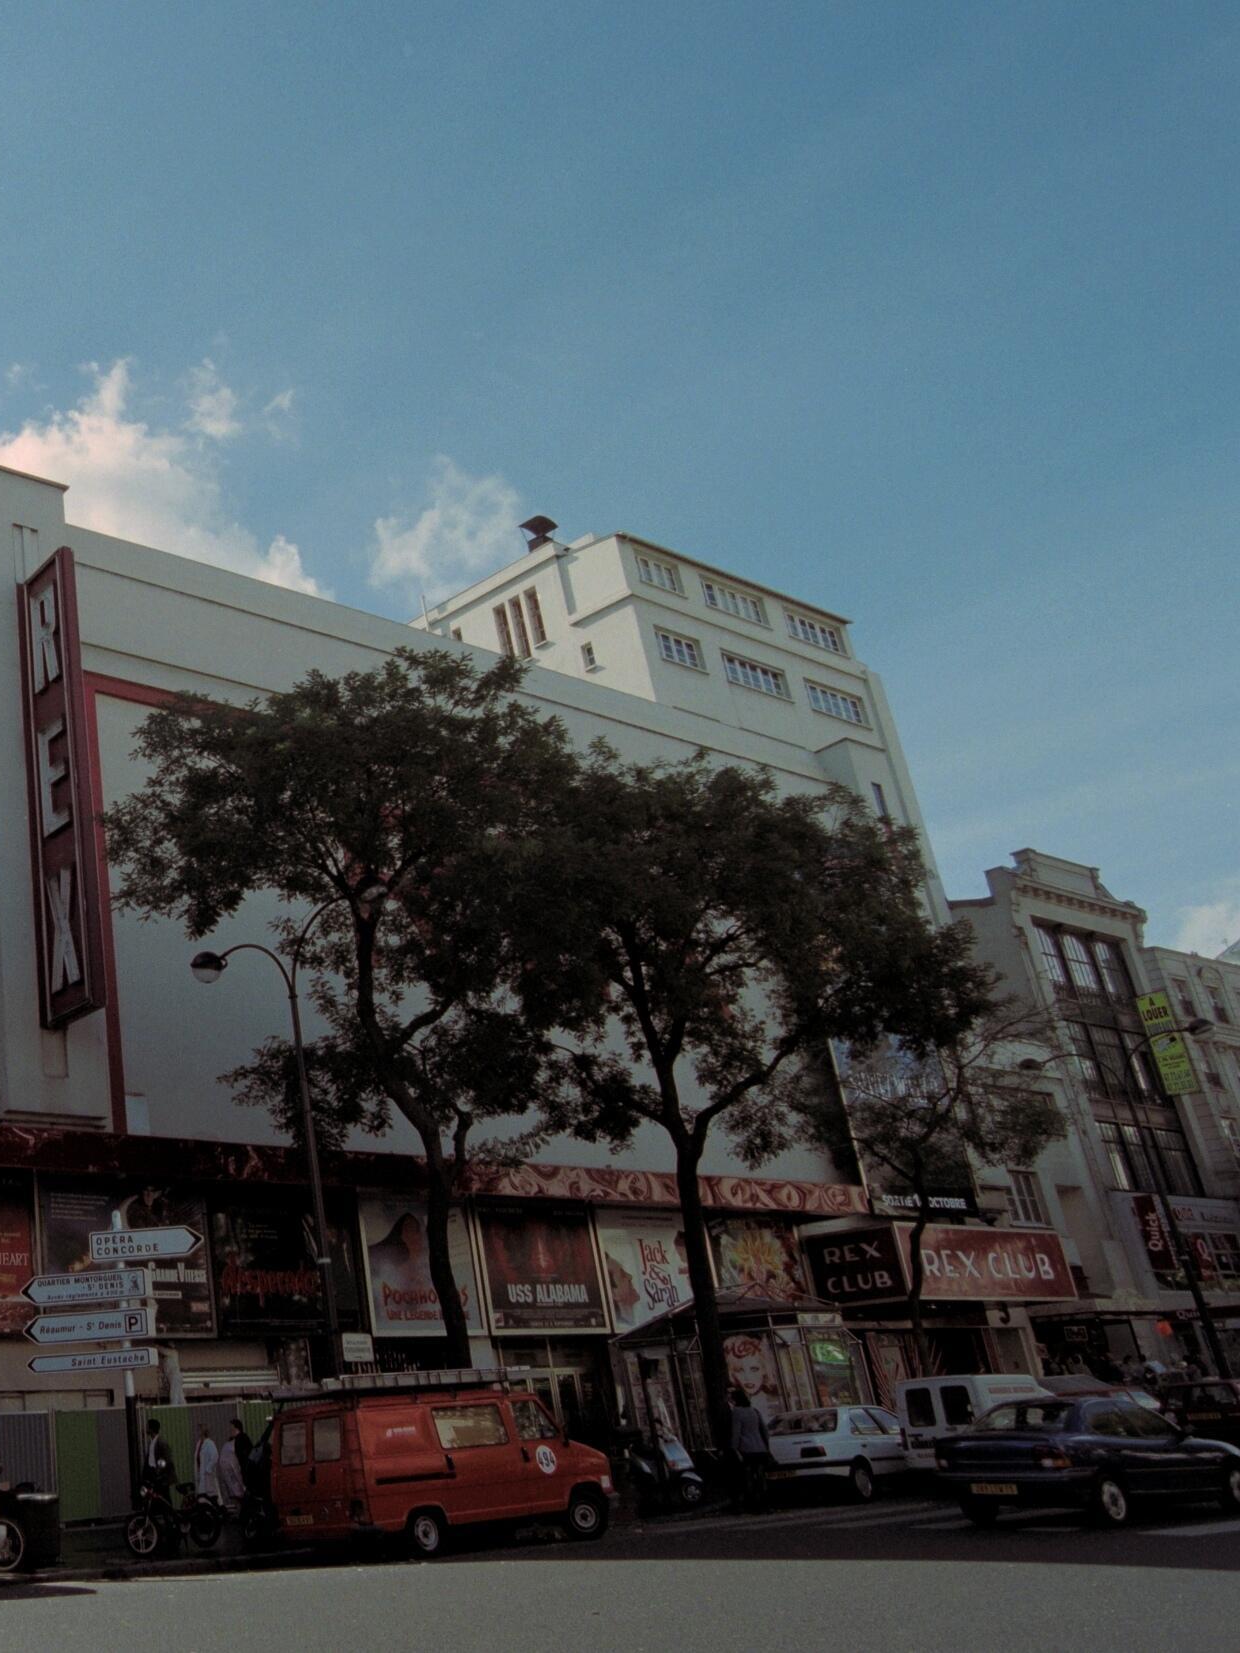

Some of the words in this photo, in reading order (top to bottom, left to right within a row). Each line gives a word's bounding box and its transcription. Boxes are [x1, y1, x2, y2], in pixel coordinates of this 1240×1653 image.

[31, 580, 84, 995] REX
[1146, 1211, 1164, 1252] Quick
[96, 1242, 160, 1256] CONCORDE
[636, 1238, 670, 1276] Jack
[823, 1241, 882, 1265] REX
[920, 1249, 982, 1280] REX
[987, 1254, 1056, 1280] CLUB
[37, 1278, 71, 1288] QUARTIER
[73, 1272, 124, 1284] MONTORGUEIL
[98, 1280, 124, 1290] DENIS
[643, 1273, 681, 1311] Sarah
[826, 1270, 893, 1294] CLUB
[382, 1280, 469, 1307] POCAHOS
[506, 1283, 534, 1303] USS
[535, 1283, 590, 1303] ALABAMA
[98, 1319, 122, 1331] Denis
[71, 1357, 97, 1368] Saint
[101, 1353, 146, 1366] Eustache
[538, 1451, 555, 1467] 494
